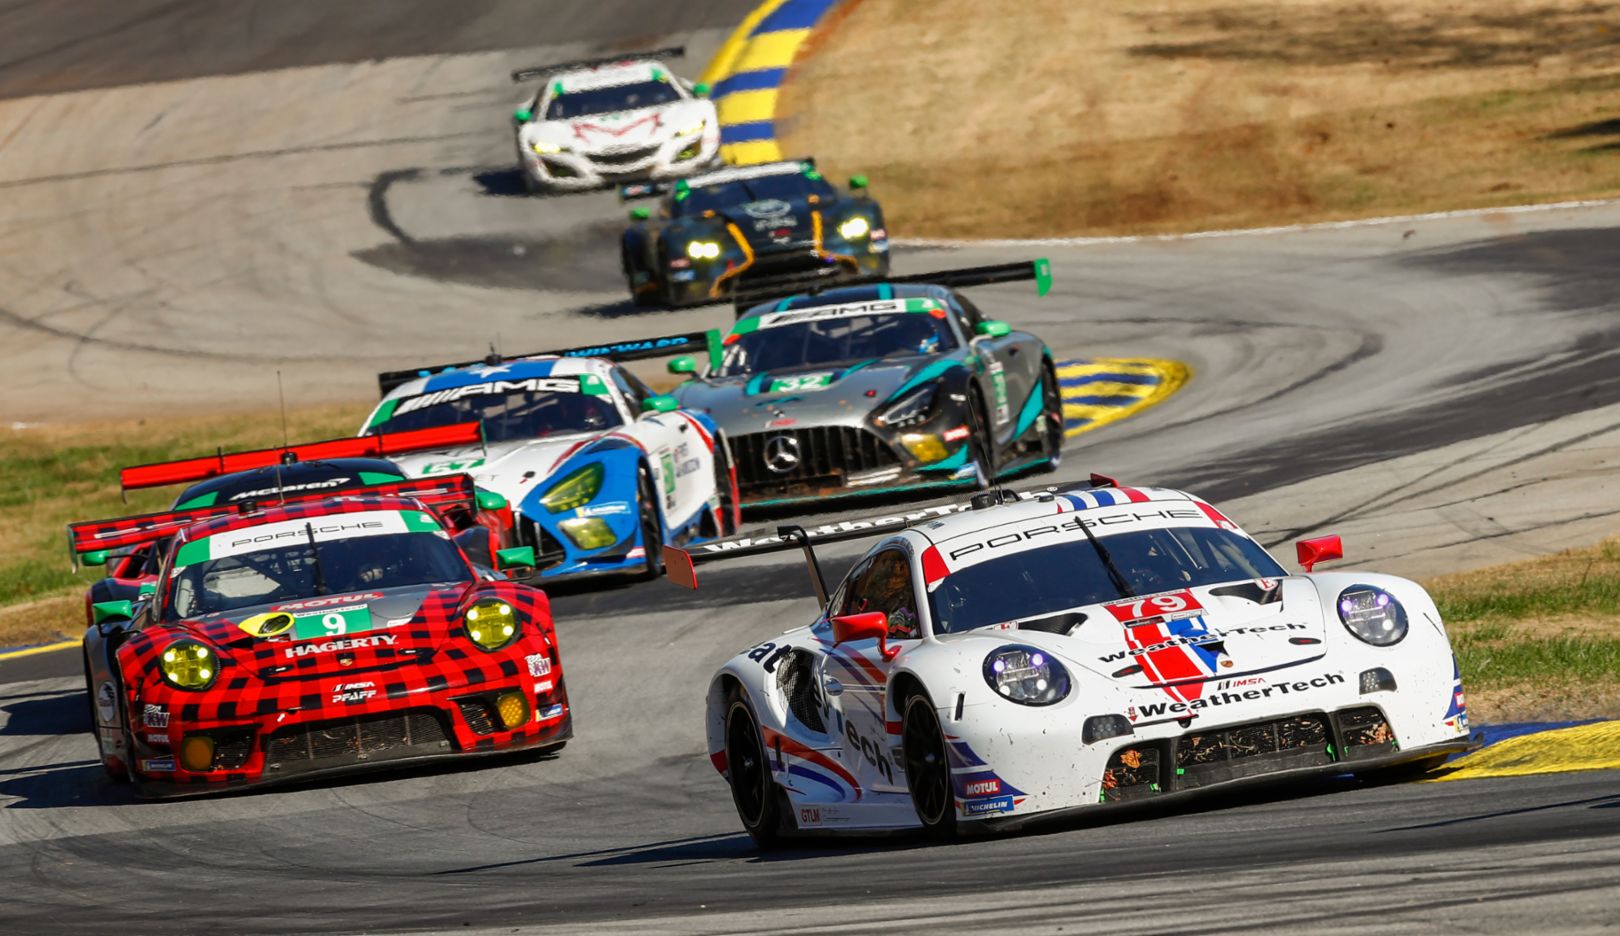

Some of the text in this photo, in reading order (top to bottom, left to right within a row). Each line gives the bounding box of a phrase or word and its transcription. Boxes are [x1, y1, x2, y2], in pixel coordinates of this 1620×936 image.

[779, 375, 824, 393] 32
[231, 521, 384, 548] PORSCHE
[949, 509, 1204, 561] PORSCHE
[277, 593, 377, 611] MOTUL
[1116, 595, 1187, 618] 79
[321, 613, 346, 637] 9
[285, 634, 397, 659] HAGERTY
[1098, 622, 1306, 663] WeatherTech
[1232, 677, 1266, 688] IMSA
[331, 690, 377, 704] PFAFF
[1139, 673, 1345, 718] WeatherTech
[966, 781, 999, 796] MOTUL
[801, 807, 822, 824] GTLM
